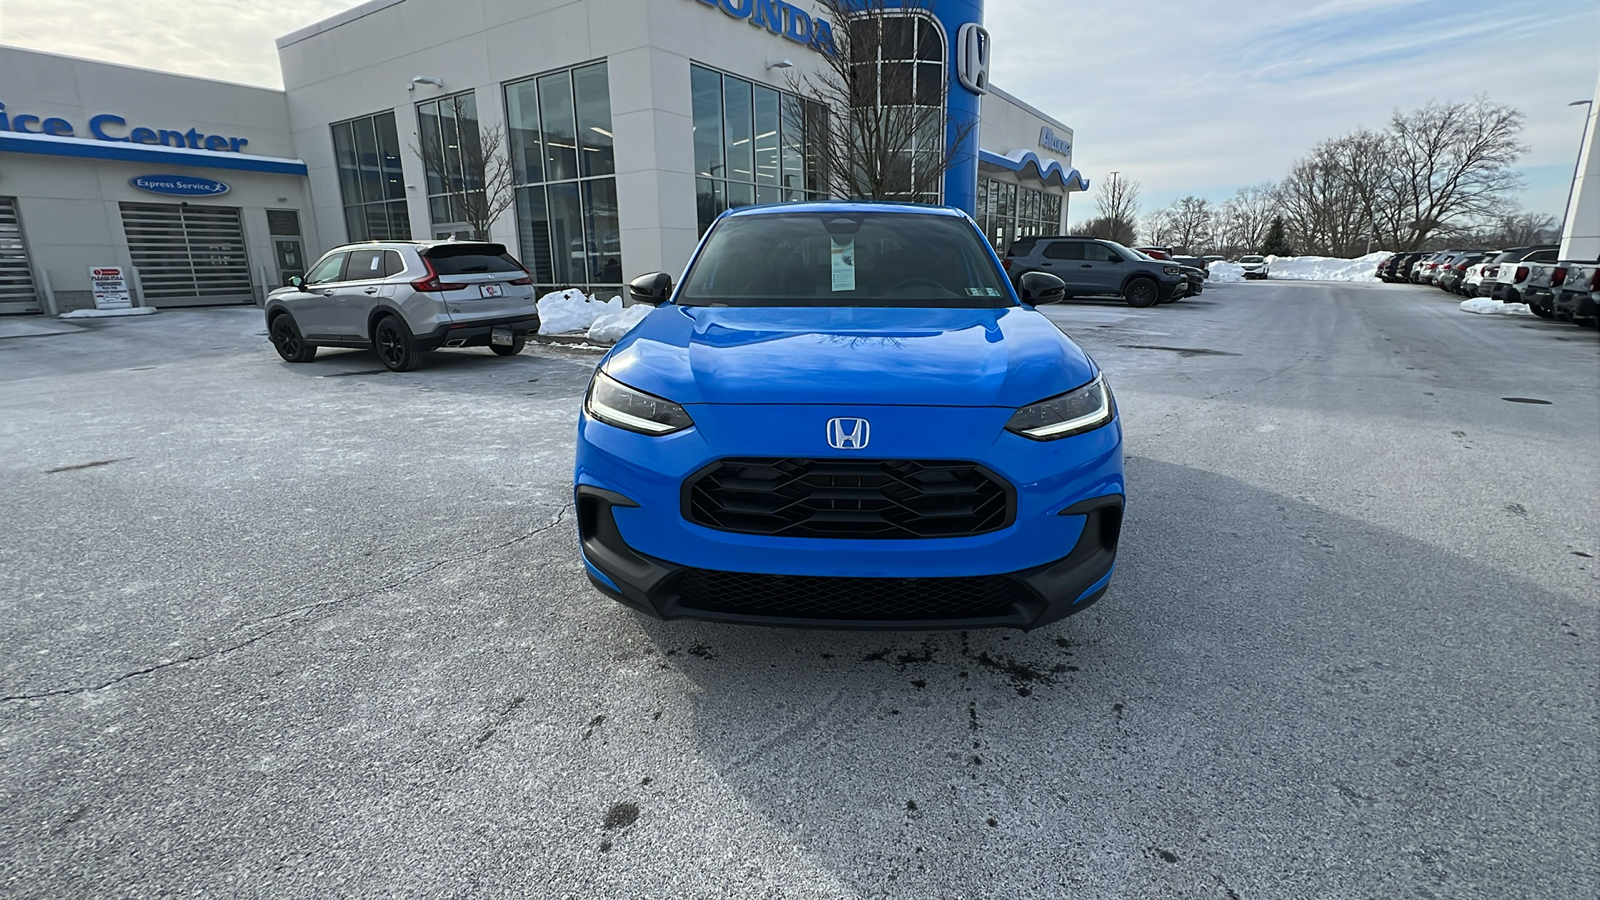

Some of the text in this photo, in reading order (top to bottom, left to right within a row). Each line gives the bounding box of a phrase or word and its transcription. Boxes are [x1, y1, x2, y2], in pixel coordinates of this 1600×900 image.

[694, 0, 842, 58] ONDA
[89, 113, 248, 152] Center
[136, 179, 210, 190] Express Service
